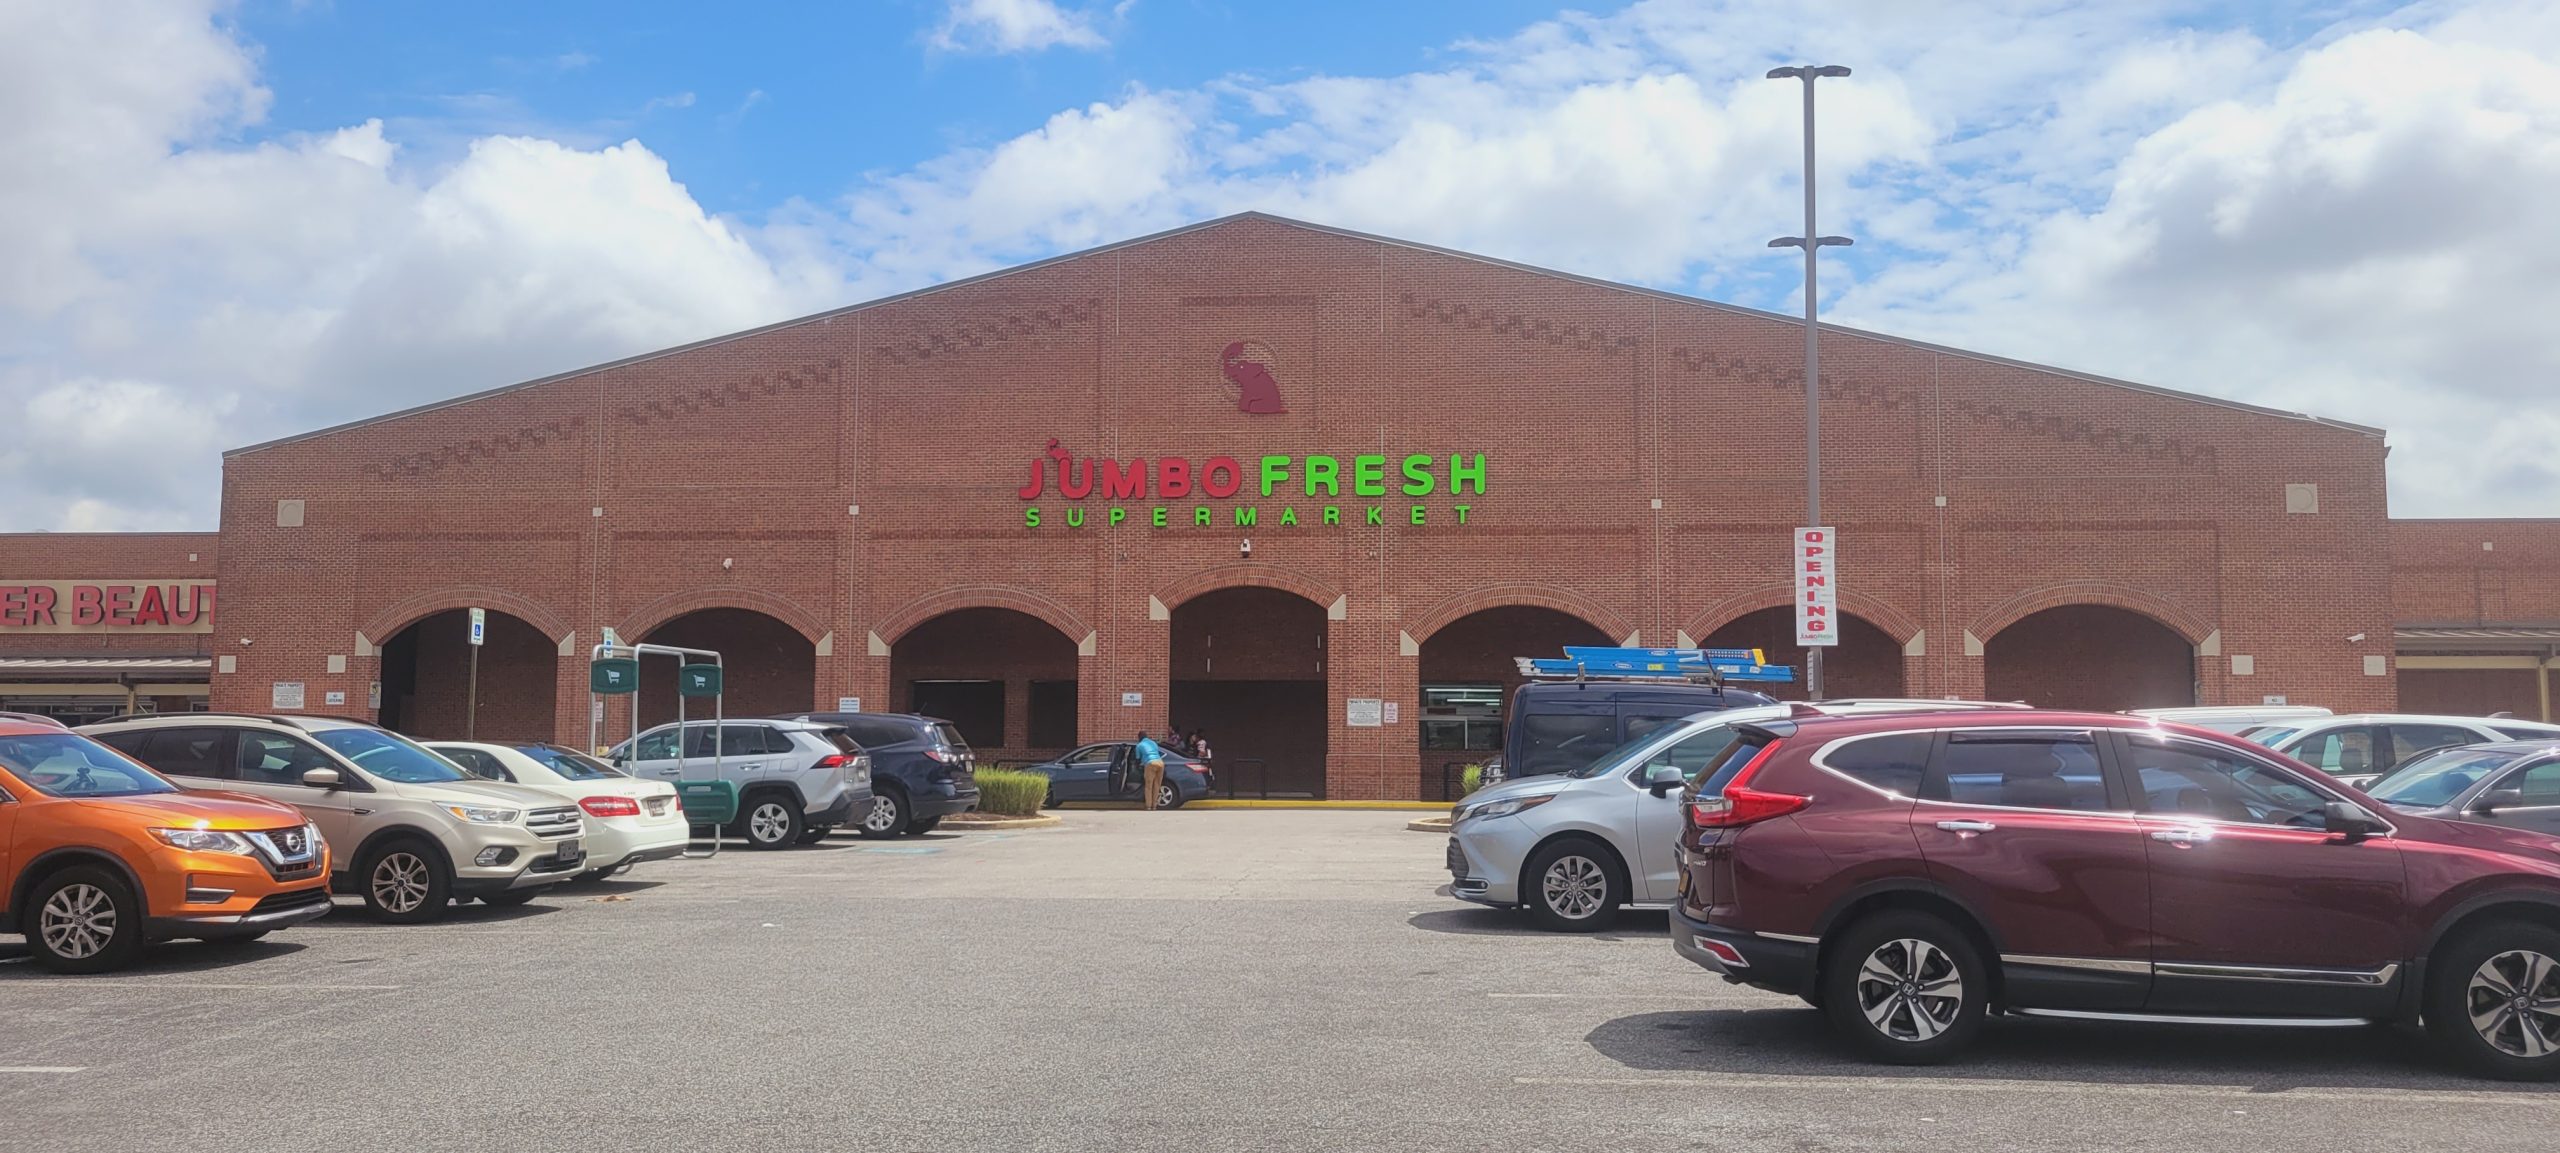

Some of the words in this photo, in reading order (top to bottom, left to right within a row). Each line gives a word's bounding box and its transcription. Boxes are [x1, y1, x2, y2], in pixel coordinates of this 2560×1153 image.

[1018, 456, 1243, 501] JUMBO
[1260, 453, 1487, 497] FRESH
[1025, 504, 1472, 528] SUPERMARKET
[1804, 531, 1826, 632] OPENING
[0, 585, 57, 626] ER
